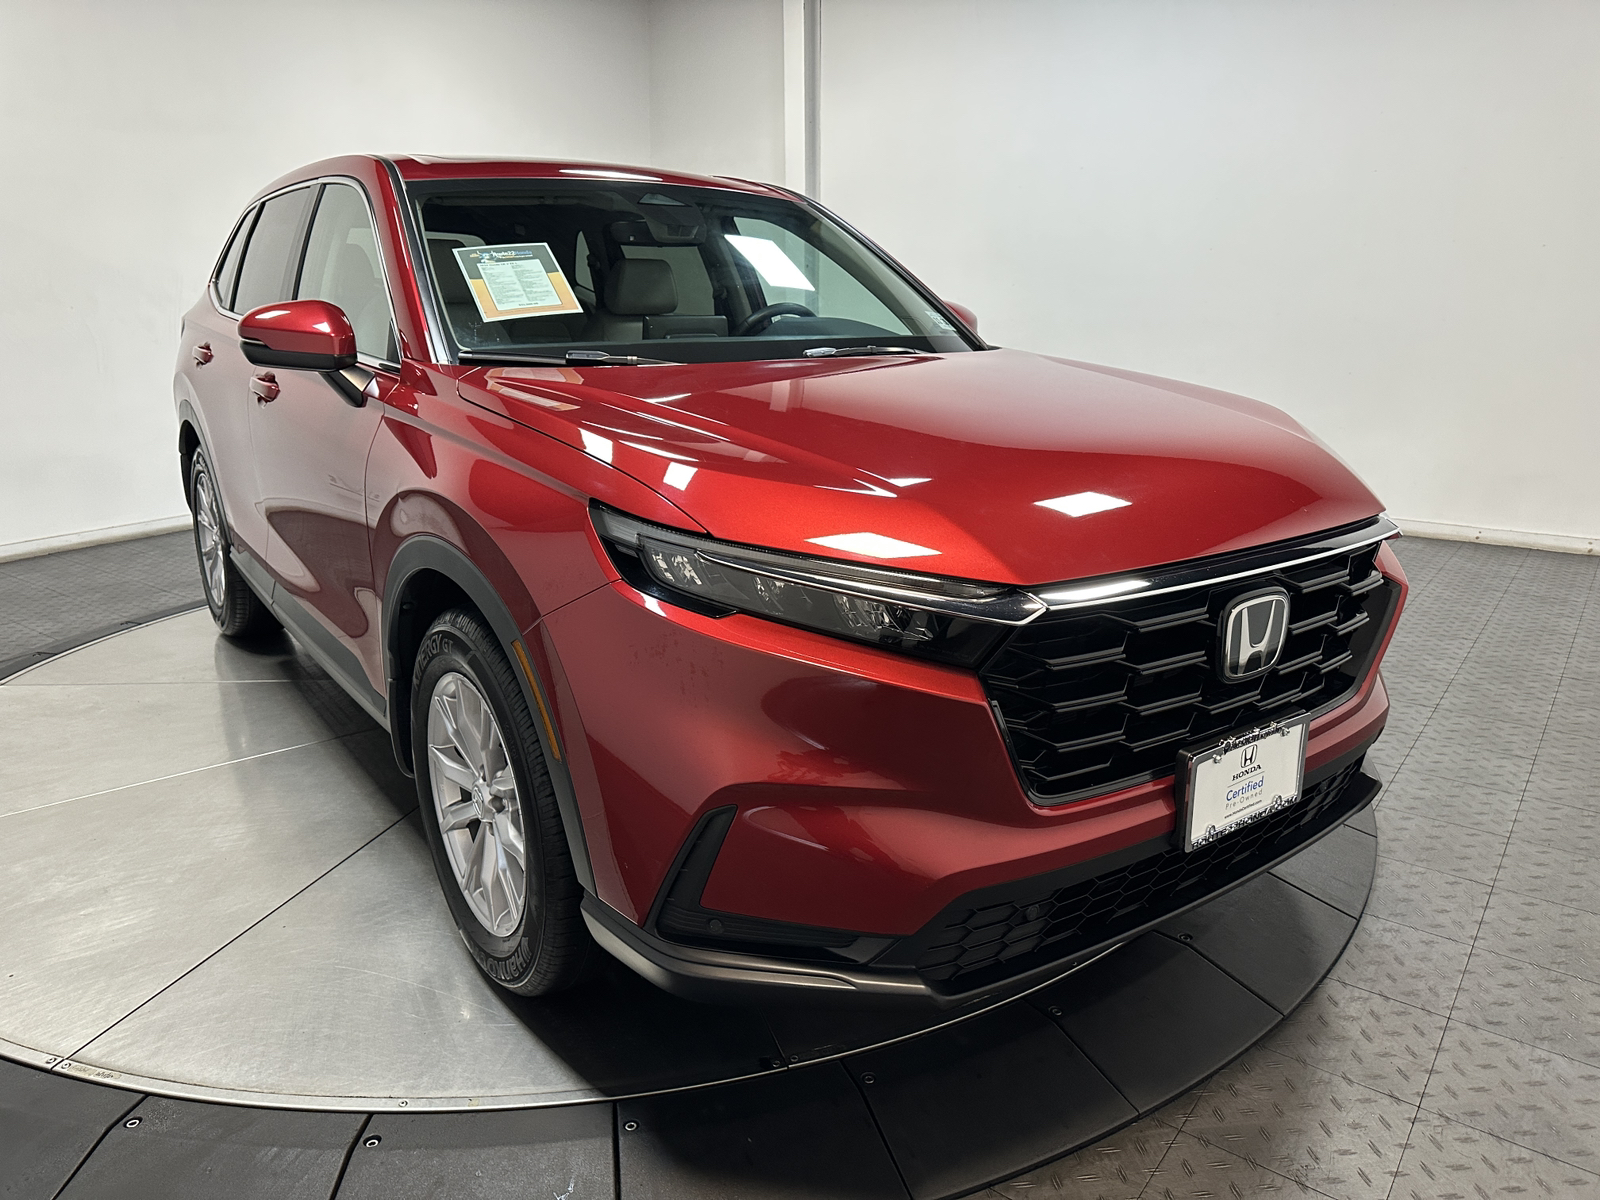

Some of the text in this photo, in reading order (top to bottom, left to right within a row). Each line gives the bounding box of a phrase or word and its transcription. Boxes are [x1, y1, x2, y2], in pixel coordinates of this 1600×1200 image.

[442, 638, 454, 654] GT
[1231, 764, 1262, 782] HONDA
[1226, 775, 1264, 802] Certified
[1225, 788, 1263, 810] Pre-Owned
